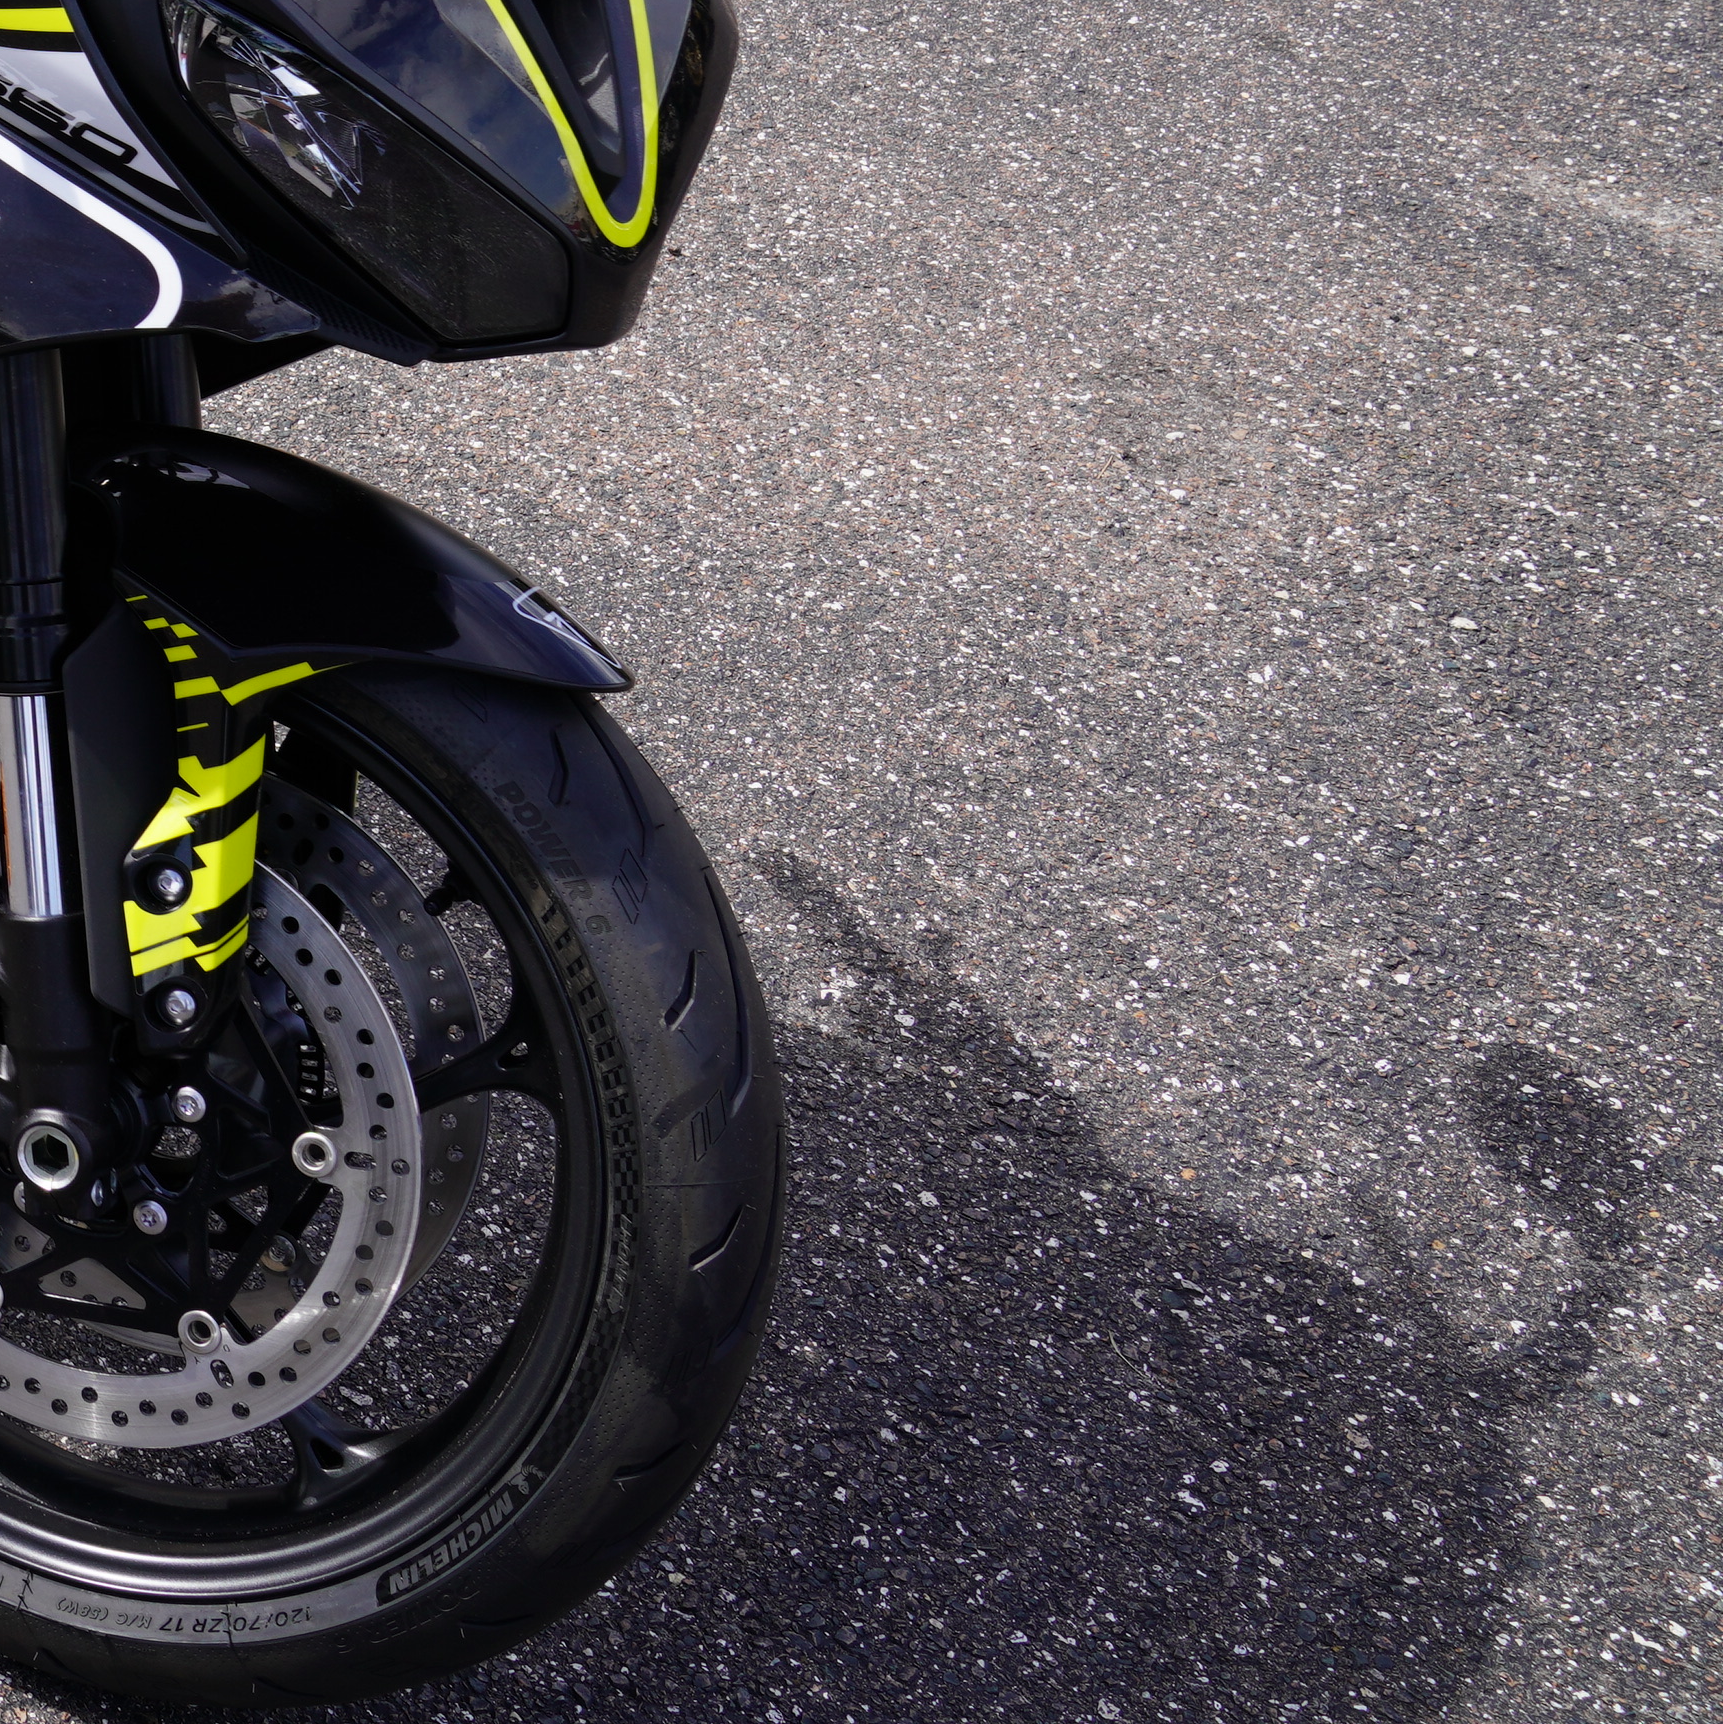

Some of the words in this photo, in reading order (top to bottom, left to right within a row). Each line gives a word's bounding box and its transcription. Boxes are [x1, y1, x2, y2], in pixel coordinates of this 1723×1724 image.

[492, 781, 594, 901] POWER
[585, 914, 613, 936] 6
[389, 1490, 515, 1595] MICHELIN
[55, 1596, 111, 1622] (58W)
[115, 1609, 153, 1628] M/C
[232, 1605, 312, 1632] 120/70
[159, 1615, 184, 1632] 17
[192, 1616, 223, 1634] ZR
